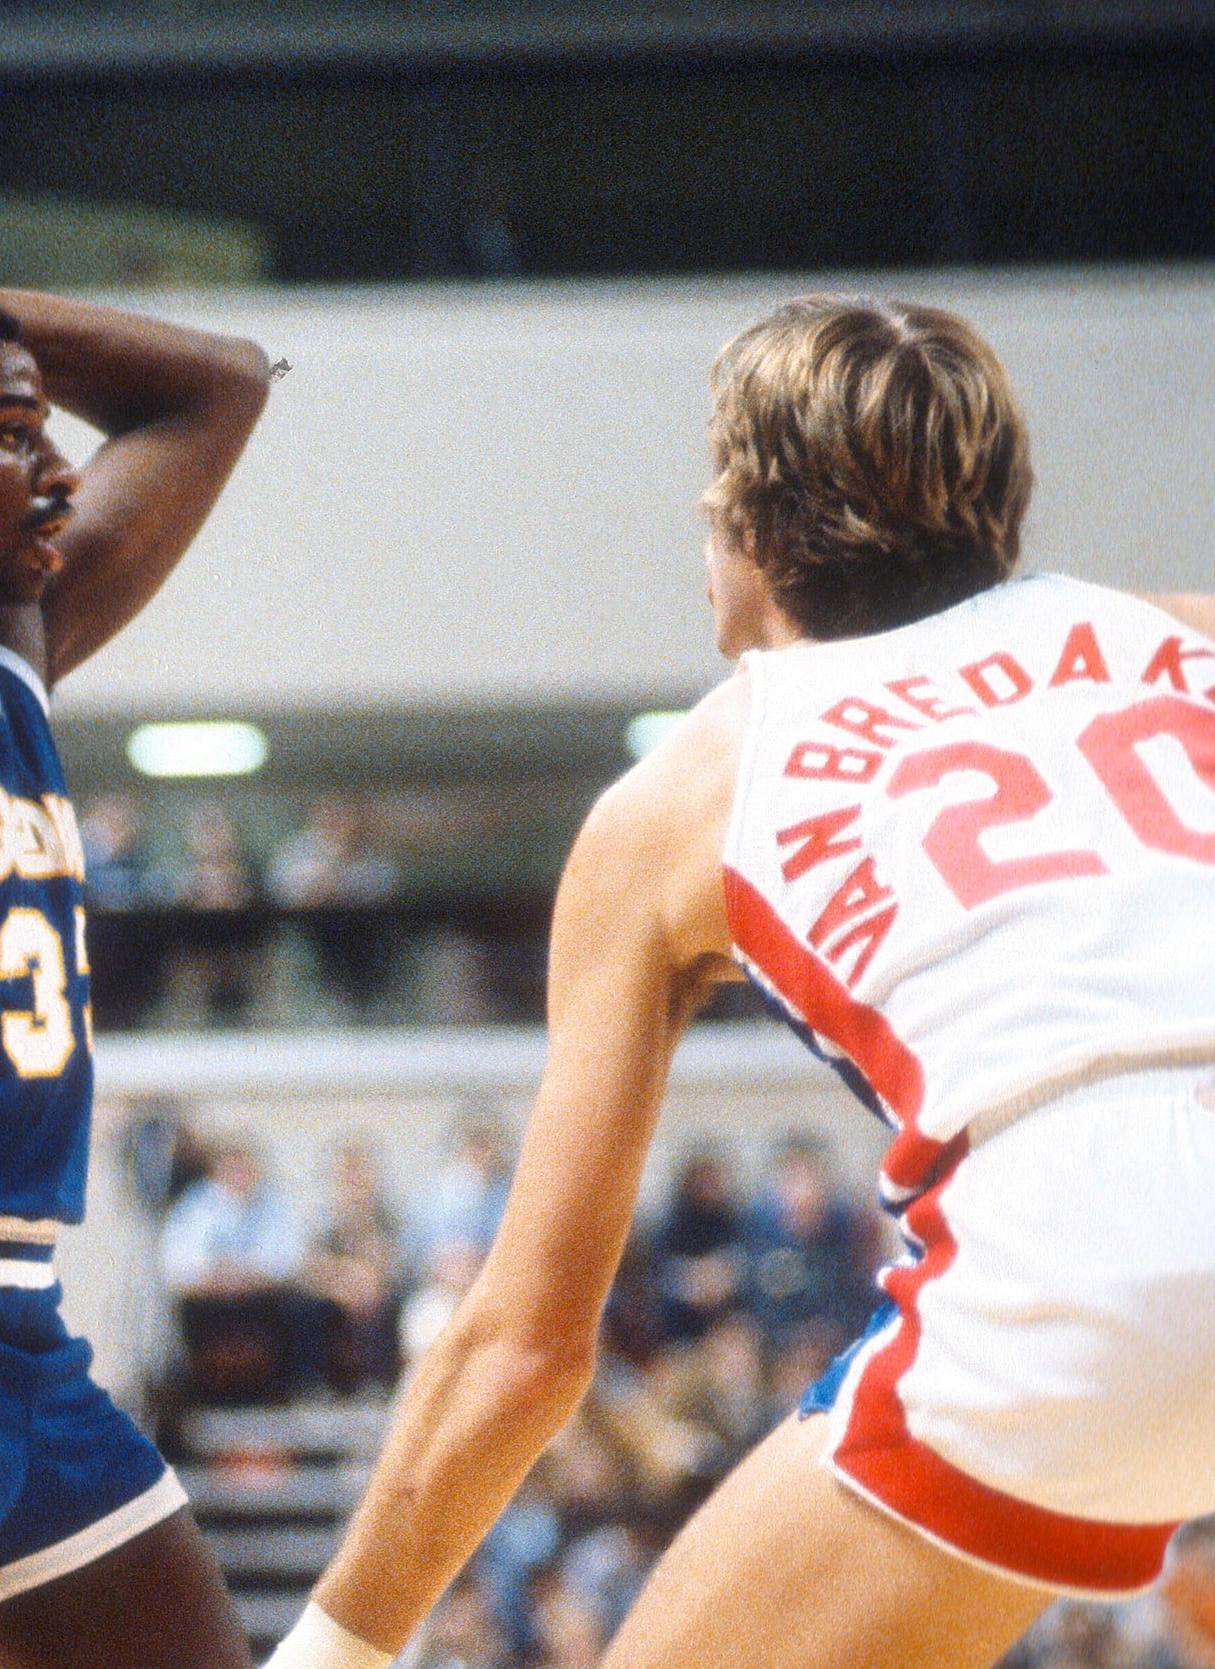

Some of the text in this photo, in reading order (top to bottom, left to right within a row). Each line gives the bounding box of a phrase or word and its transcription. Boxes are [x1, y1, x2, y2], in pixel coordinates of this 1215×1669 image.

[776, 803, 899, 990] VAN
[1140, 634, 1215, 703] K
[886, 694, 1215, 911] 20
